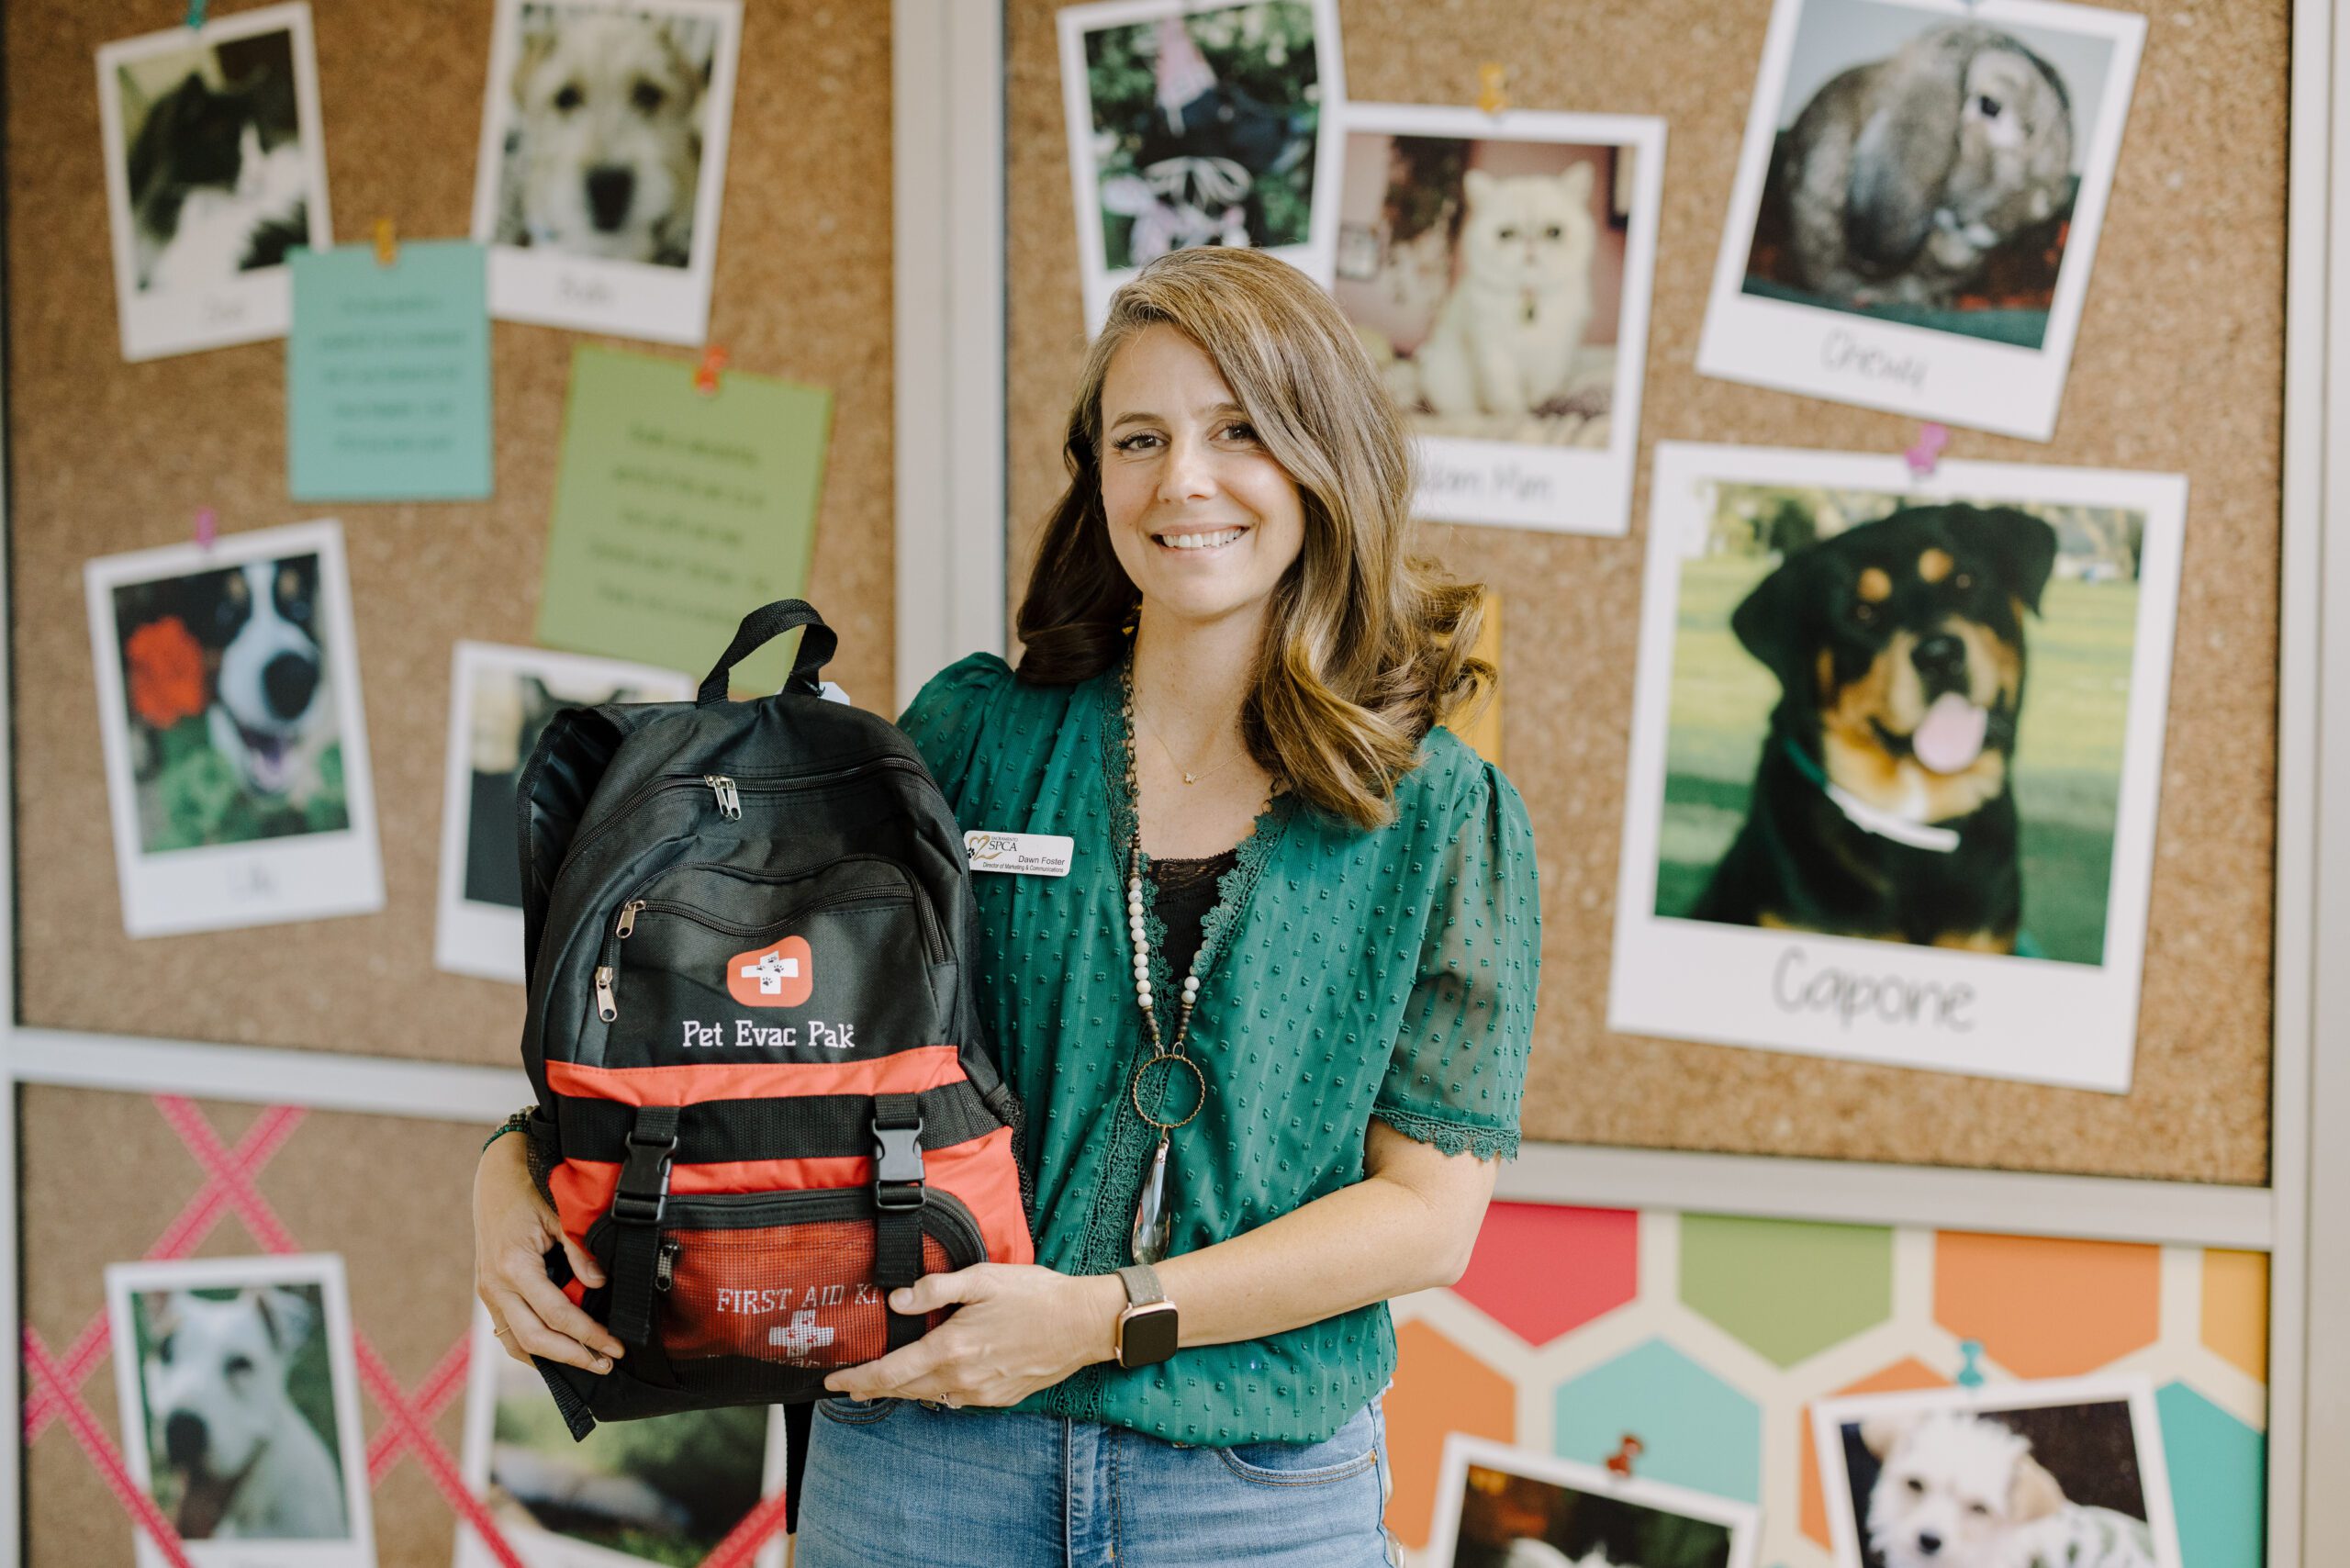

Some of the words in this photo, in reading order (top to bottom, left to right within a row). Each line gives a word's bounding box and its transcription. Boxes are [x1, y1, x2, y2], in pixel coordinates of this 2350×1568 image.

[989, 840, 1017, 852] SPCA
[1004, 864, 1024, 872] Marketing
[1018, 855, 1039, 864] Dawn
[1041, 857, 1065, 866] Foster
[1772, 946, 1976, 1033] Capone
[682, 1020, 723, 1047] Pet
[735, 1020, 796, 1047] Evac
[716, 1287, 793, 1315] FIRST
[801, 1285, 845, 1307] AID
[855, 1283, 878, 1305] KI
